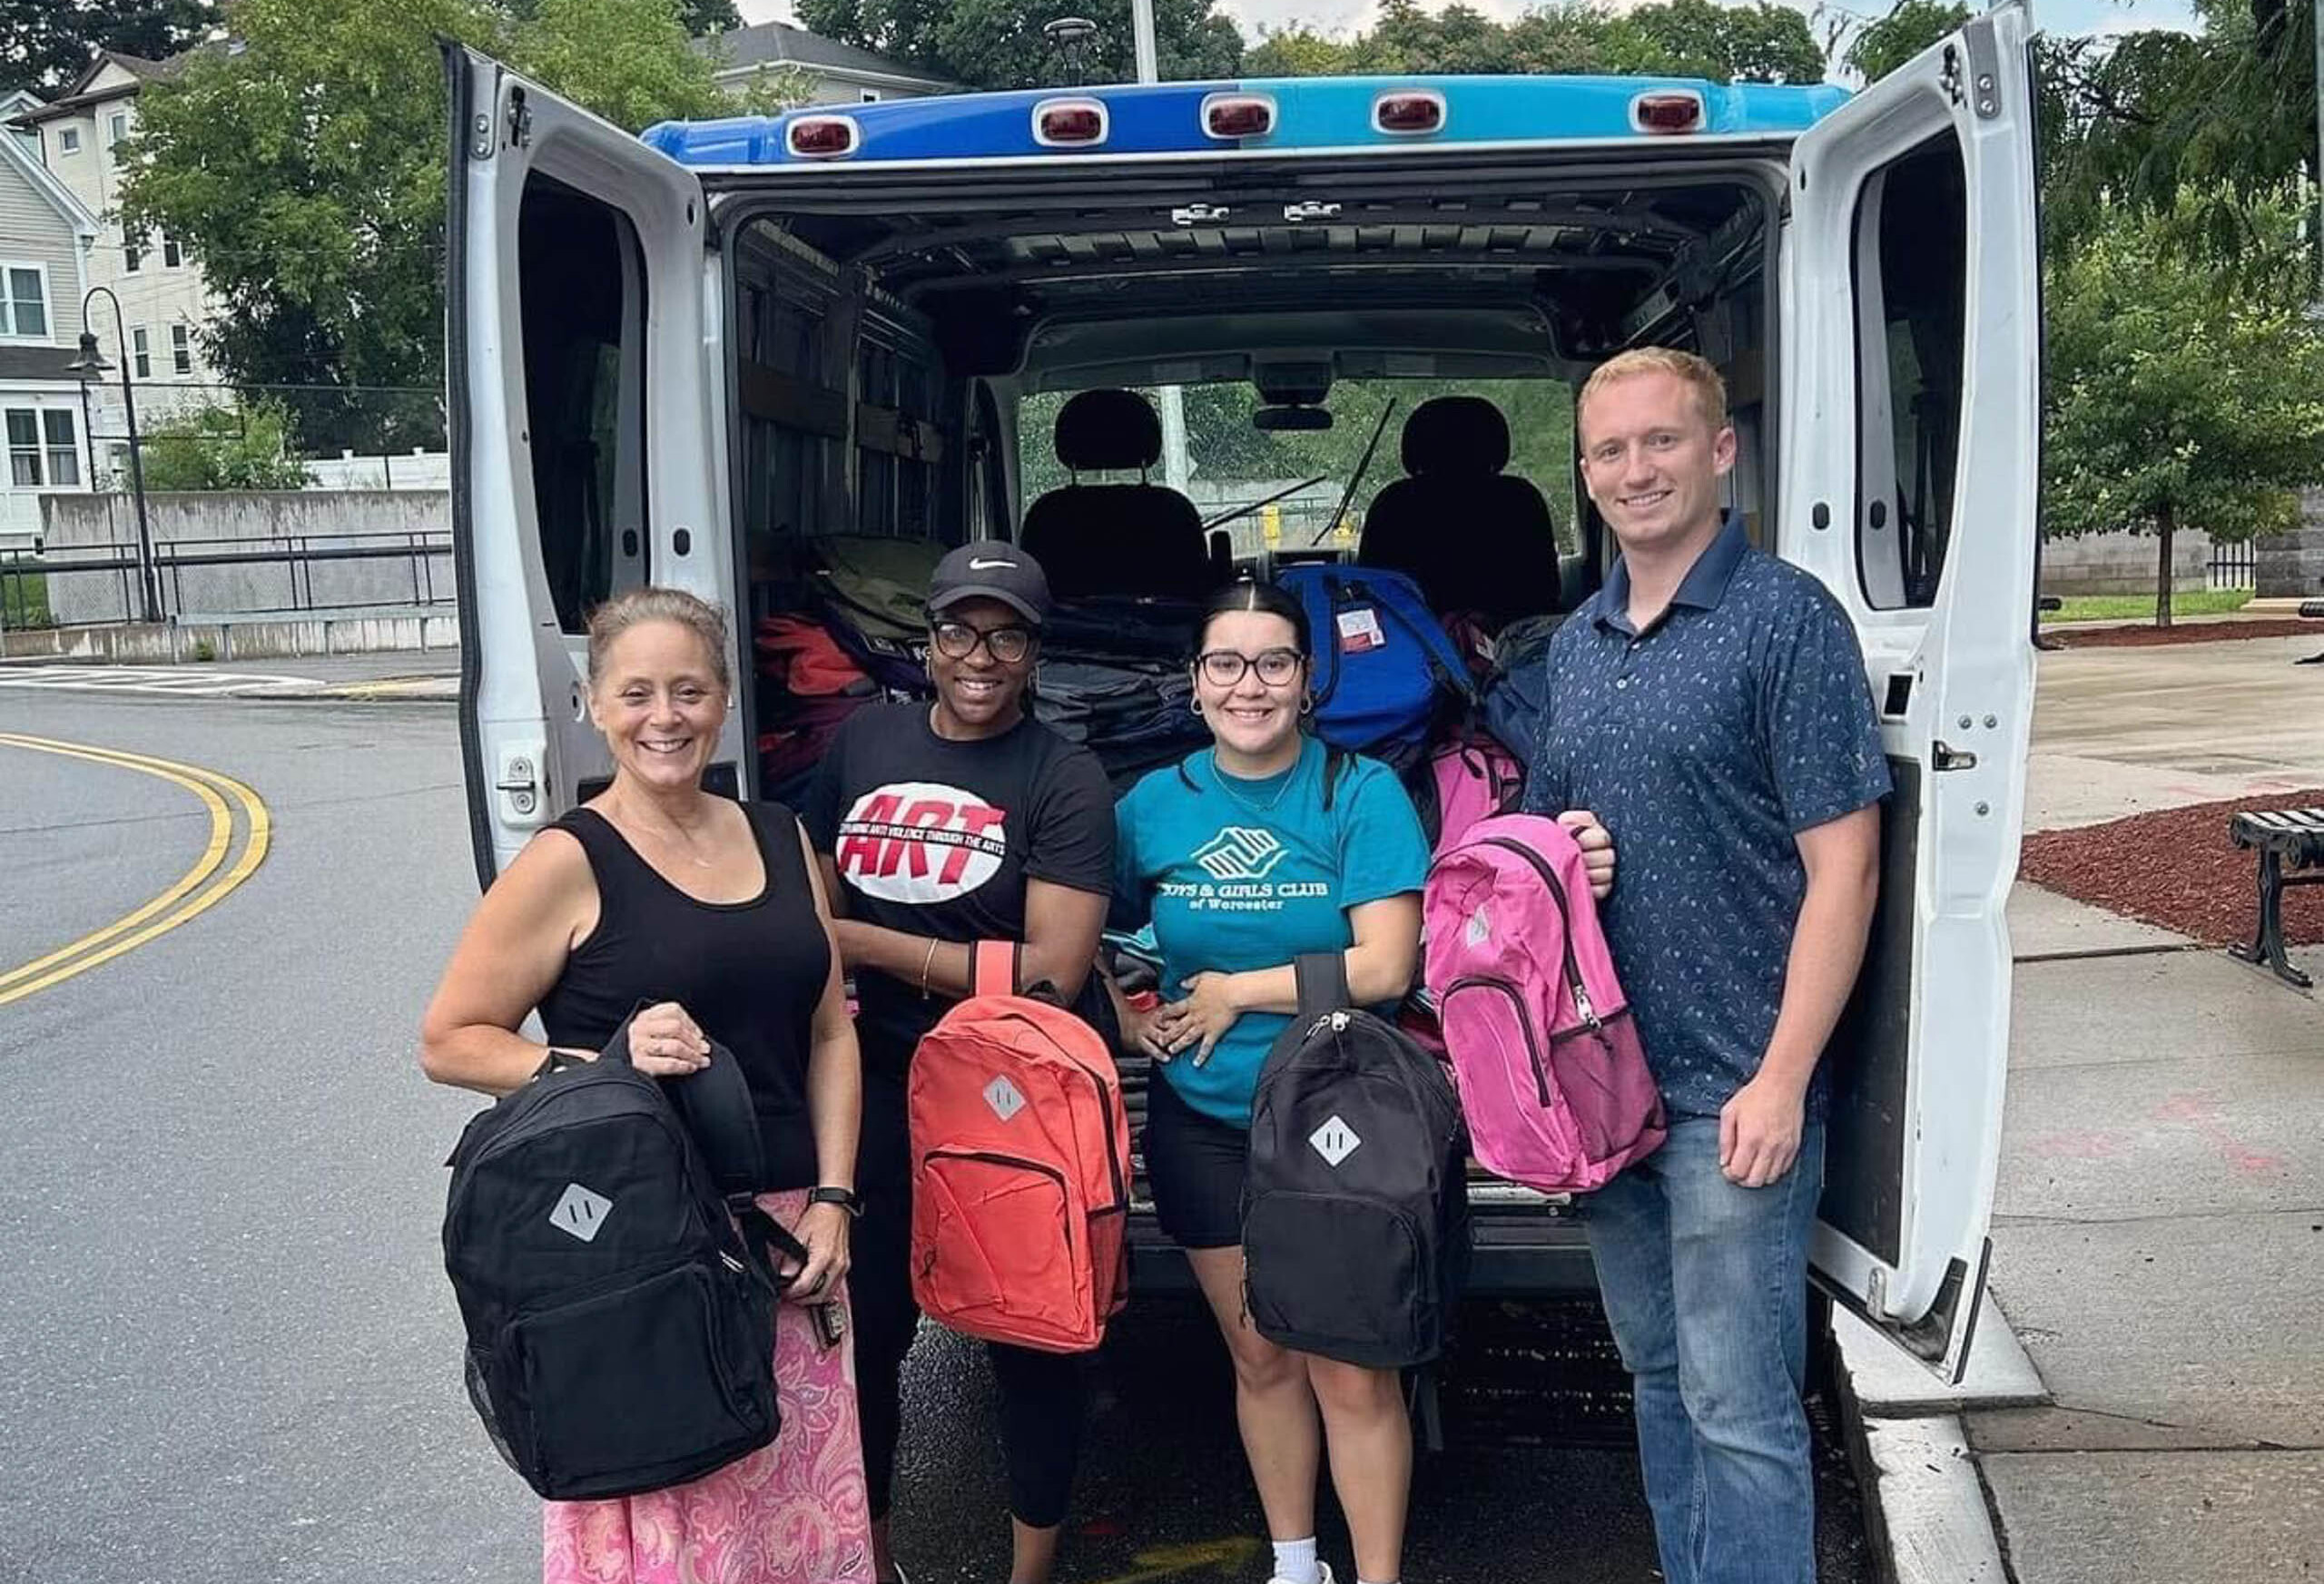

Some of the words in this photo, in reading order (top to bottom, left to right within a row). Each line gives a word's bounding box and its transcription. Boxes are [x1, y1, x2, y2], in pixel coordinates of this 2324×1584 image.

[838, 794, 1008, 884] ART
[983, 841, 1005, 855] ARTS
[1199, 884, 1215, 897] &
[1218, 882, 1273, 897] GIRLS
[1277, 882, 1328, 897] CLUB
[1189, 898, 1206, 910] of
[1208, 899, 1285, 911] Worcester
